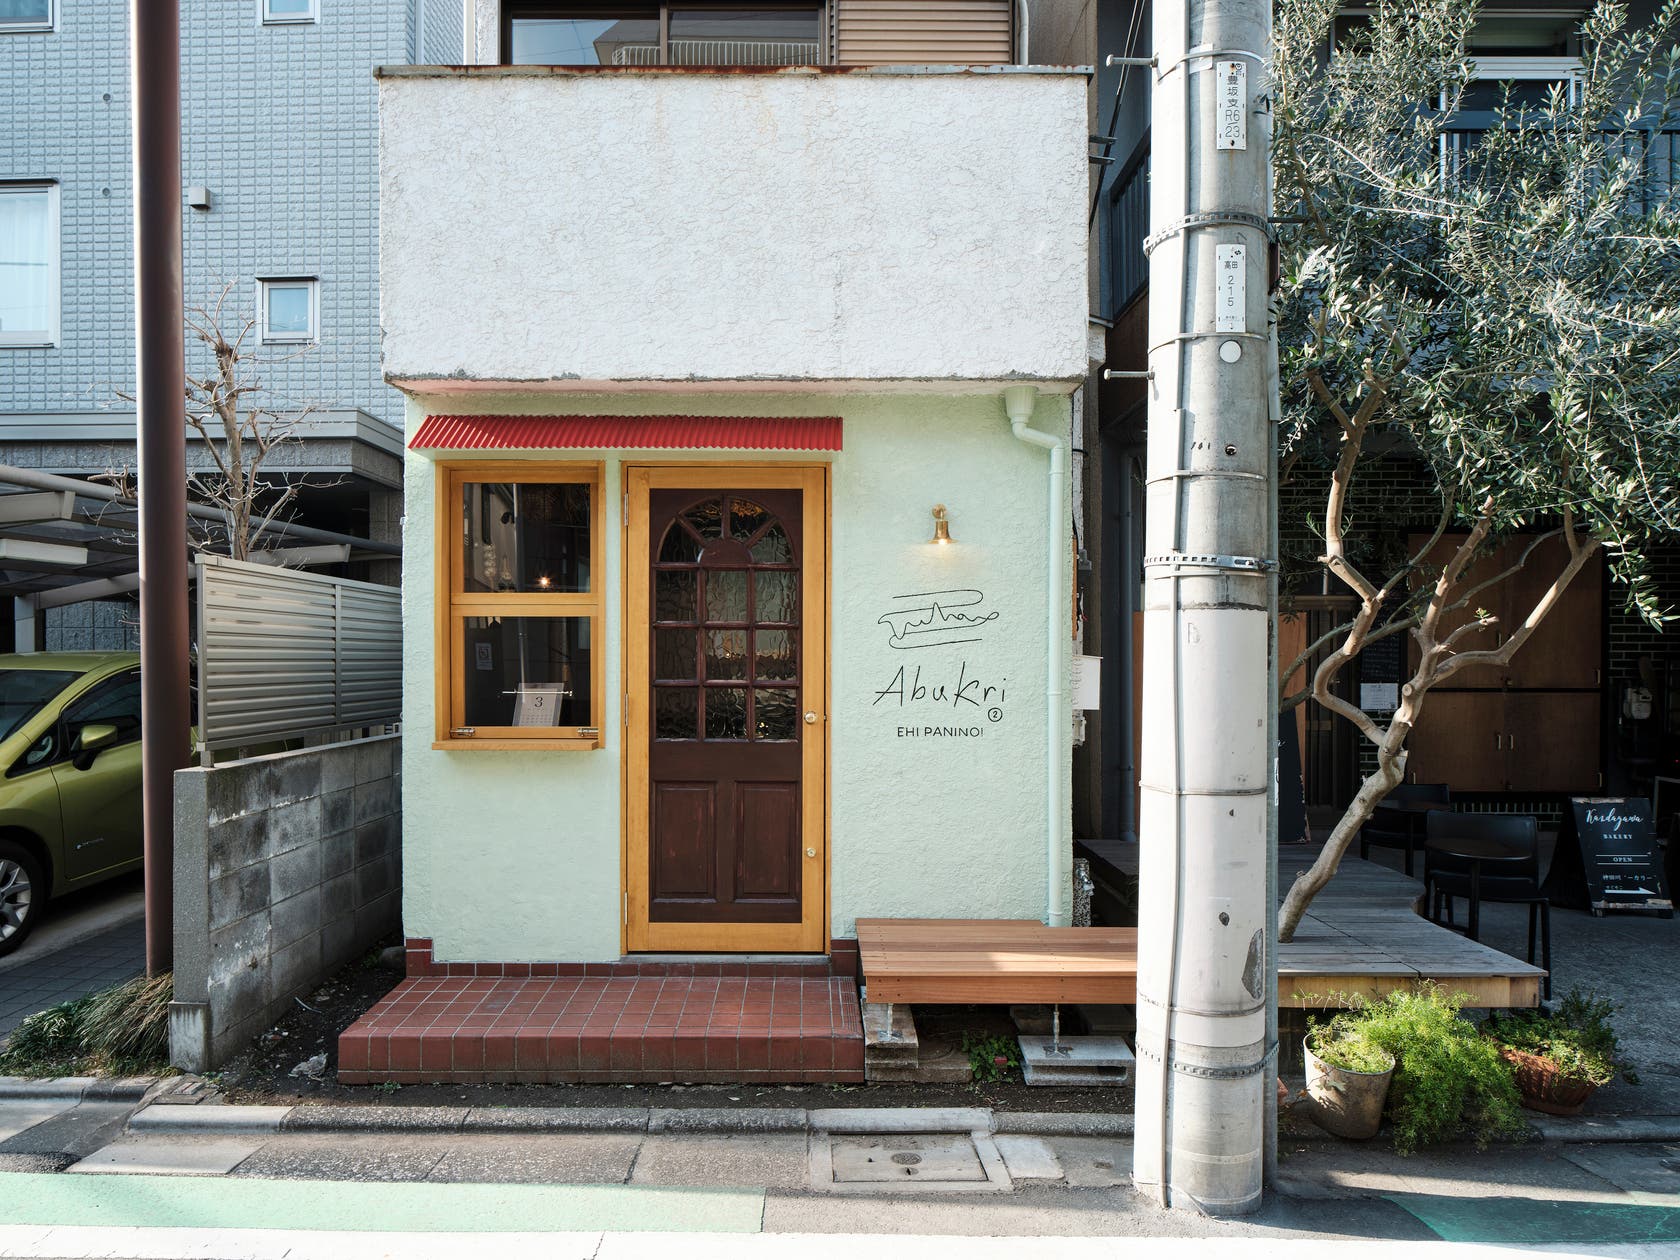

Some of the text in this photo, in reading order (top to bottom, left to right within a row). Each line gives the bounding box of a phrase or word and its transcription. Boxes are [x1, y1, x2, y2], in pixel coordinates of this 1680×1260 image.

[1225, 125, 1240, 138] 23
[1224, 260, 1238, 269] 高田
[873, 661, 1007, 707] Abukri
[534, 696, 544, 708] 3
[897, 727, 984, 738] EHI PANINO!
